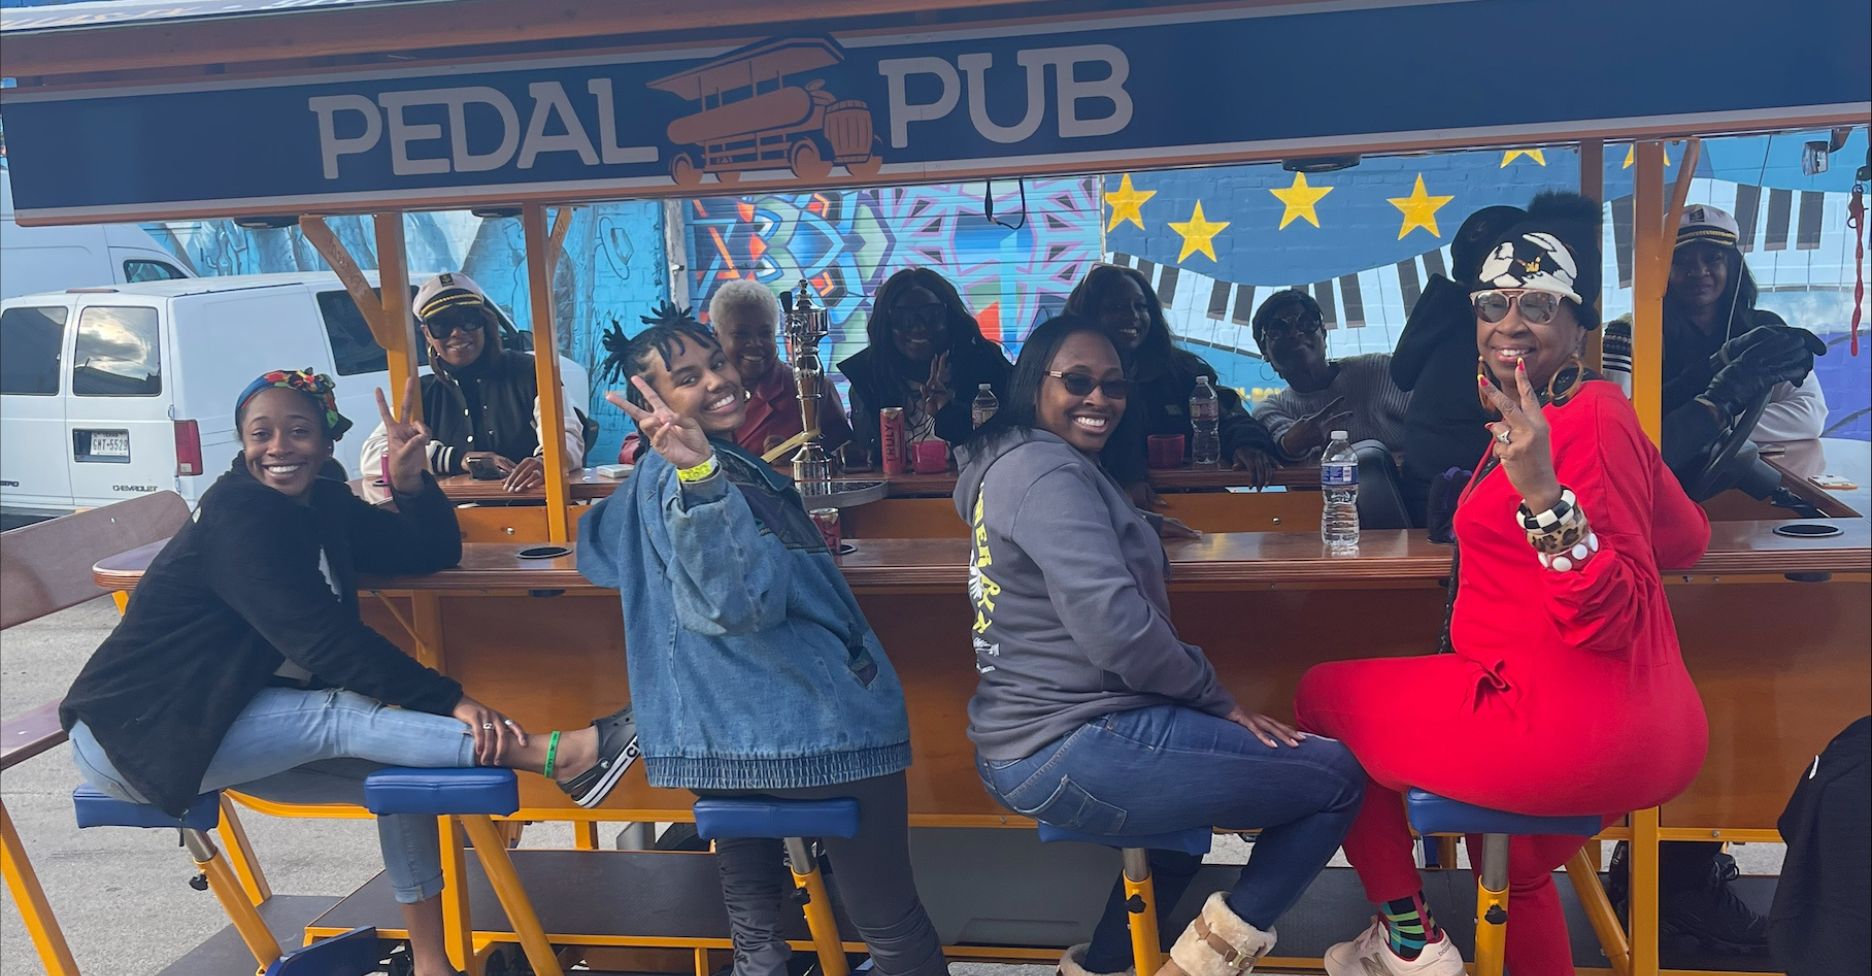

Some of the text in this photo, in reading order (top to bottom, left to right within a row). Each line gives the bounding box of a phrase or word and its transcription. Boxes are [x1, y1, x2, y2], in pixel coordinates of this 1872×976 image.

[309, 44, 1134, 179] PEDAL PUB
[884, 424, 898, 464] TRULY
